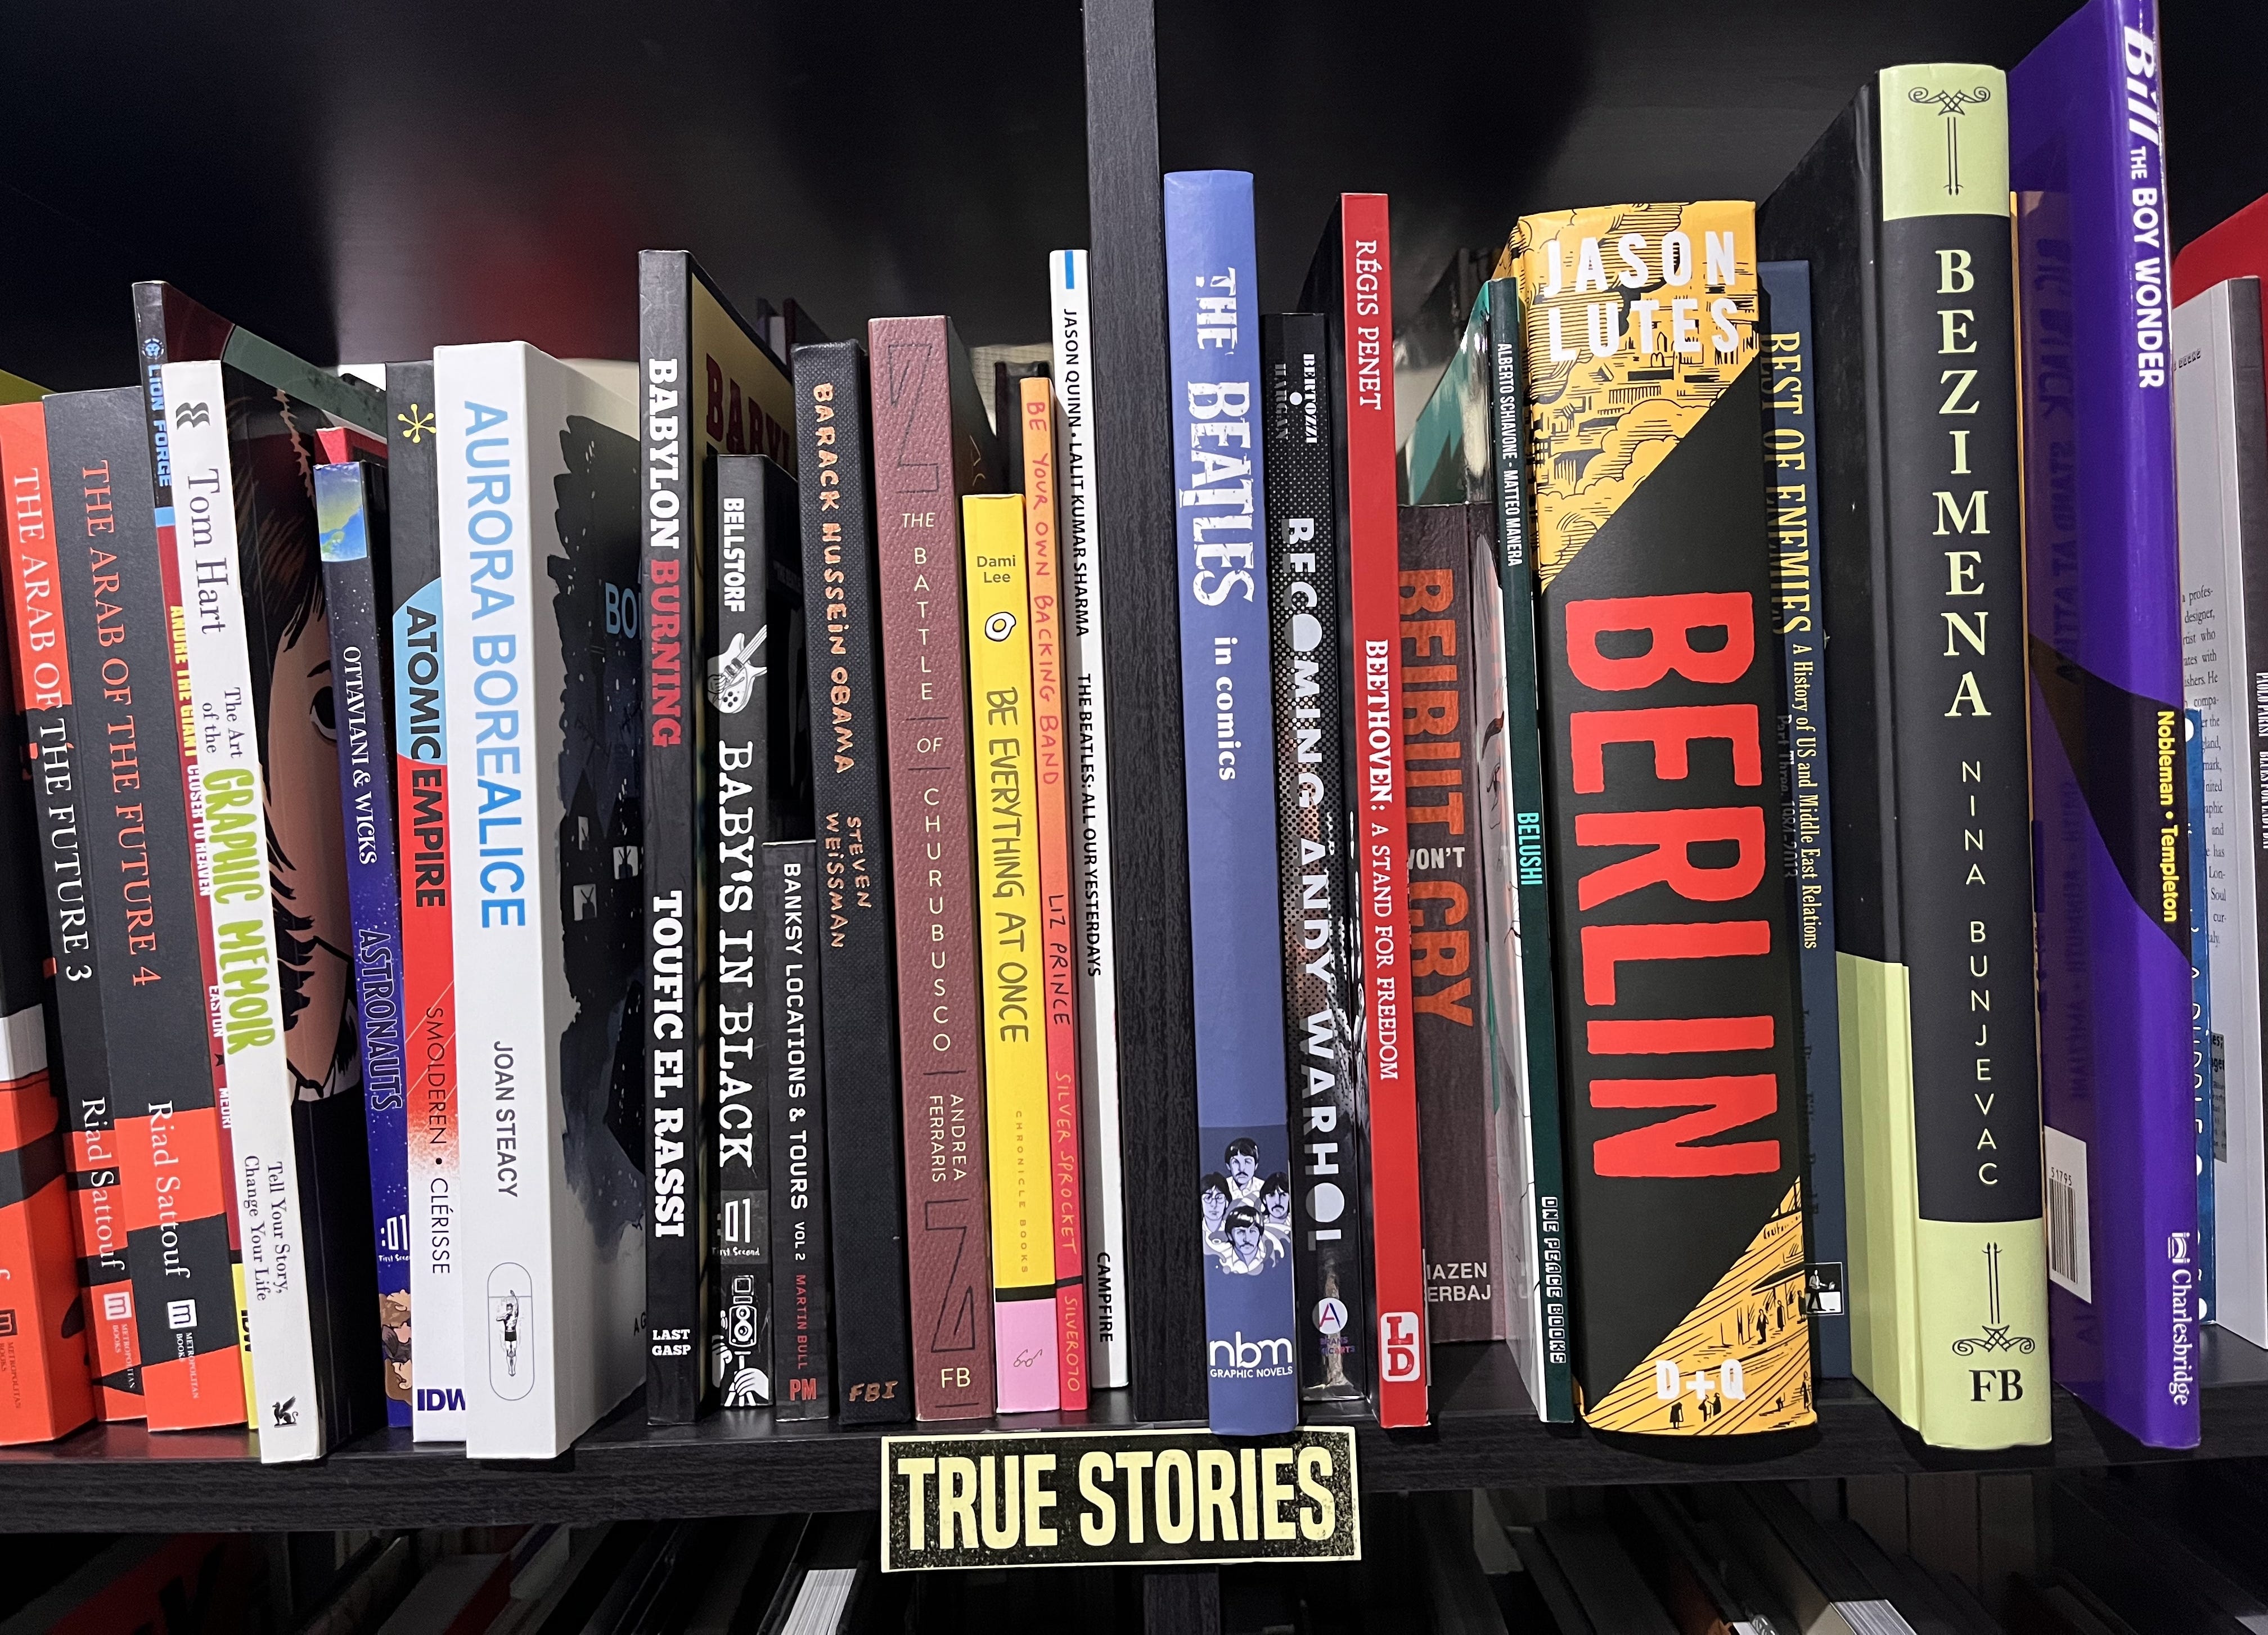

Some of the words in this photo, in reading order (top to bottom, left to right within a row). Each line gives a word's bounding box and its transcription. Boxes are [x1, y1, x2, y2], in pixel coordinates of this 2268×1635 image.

[2125, 26, 2159, 146] Bill
[2130, 146, 2146, 179] THE
[2132, 188, 2159, 248] BOY
[1355, 240, 1382, 316] RÉGIS
[1543, 231, 1736, 299] JASON
[1064, 308, 1078, 365] JASON
[1195, 267, 1238, 355] THE
[1547, 297, 1740, 364] LUTES
[2135, 257, 2165, 388] WONDER
[148, 364, 164, 411] LION
[1065, 370, 1082, 427] QUINN
[1303, 354, 1317, 443] BERTOZZI
[1357, 326, 1382, 411] PENET
[1497, 343, 1515, 394] ALBERTO
[1027, 402, 1047, 432] BE
[1500, 397, 1518, 460] SCHIAVONE
[649, 358, 681, 549] BABYLON
[1032, 453, 1050, 510] YOUR
[1069, 443, 1083, 490] LALIT
[1932, 249, 1991, 717] BEZIMENA
[14, 467, 46, 544] THE
[82, 460, 115, 537] THE
[187, 469, 220, 548] Tom
[464, 400, 515, 620] AURORA
[902, 512, 936, 528] THE
[1180, 381, 1256, 607] BEATLES
[1503, 469, 1520, 516] MATTEO
[723, 497, 745, 612] BELLSTORF
[1035, 522, 1050, 576] OWN
[1071, 495, 1086, 557] KUMAR
[1505, 518, 1522, 567] MANERA
[813, 382, 841, 511] BARACK
[830, 666, 854, 774] OBAMA
[976, 555, 1016, 567] Dami
[984, 570, 1011, 583] Lee
[22, 555, 56, 652] ARAB
[90, 547, 125, 647] ARAB
[195, 558, 228, 634] Hart
[1074, 562, 1089, 637] SHARMA
[2184, 609, 2215, 625] designer,
[2189, 584, 2213, 606] profes-
[650, 559, 682, 747] BURNING
[1034, 595, 1056, 702] BACKING
[1793, 643, 1812, 655] A
[2200, 628, 2216, 642] who
[2202, 648, 2217, 663] with
[35, 661, 62, 709] OF
[101, 658, 132, 705] OF
[224, 687, 242, 722] The
[343, 646, 370, 765] OTTAVIANI
[406, 606, 442, 760] ATOMIC
[986, 687, 1019, 727] BE
[1078, 673, 1092, 706] THE
[1792, 661, 1814, 711] History
[2207, 670, 2218, 684] He
[202, 702, 219, 720] of
[204, 724, 221, 753] the
[1216, 676, 1242, 781] comics
[1366, 639, 1392, 812] BEETHOVEN:
[1796, 717, 1816, 732] of
[2210, 714, 2220, 727] the
[40, 719, 72, 795] THE
[107, 715, 141, 794] THE
[228, 728, 245, 759] Art
[916, 737, 943, 753] OF
[1040, 715, 1059, 785] BAND
[1079, 711, 1094, 788] BEATLES:
[1796, 737, 1816, 758] US
[1797, 763, 1818, 787] and
[2158, 710, 2176, 806] Nobleman
[353, 769, 371, 788] &
[472, 634, 526, 929] BOREALICE
[1082, 792, 1096, 824] ALL
[203, 768, 264, 904] GRAPHIC
[354, 791, 377, 864] WICKS
[412, 769, 446, 907] EMPIRE
[719, 740, 754, 913] BABY'S
[988, 738, 1025, 898] EVERYTHING
[1083, 828, 1097, 866] OUR
[1371, 822, 1389, 837] A
[1518, 812, 1544, 885] BELUSHI
[1799, 794, 1820, 843] Middle
[2211, 822, 2224, 836] and
[49, 804, 89, 954] FUTURE
[115, 803, 157, 955] FUTURE
[847, 816, 872, 908] STEVEN
[1372, 845, 1393, 917] STAND
[1801, 848, 1821, 880] East
[2161, 824, 2180, 923] Templeton
[2213, 846, 2225, 858] has
[784, 863, 803, 954] BANKSY
[1048, 894, 1066, 929] LIZ
[1565, 591, 1781, 1178] BERLIN
[2211, 887, 2226, 901] Soul
[995, 912, 1027, 953] AT
[1084, 868, 1101, 977] YESTERDAYS
[1375, 925, 1394, 969] FOR
[1802, 885, 1822, 949] Relations
[66, 966, 92, 981] 3
[132, 966, 161, 986] 4
[217, 920, 275, 1055] MEMOIR
[652, 890, 683, 1040] TOUFIC
[719, 929, 754, 988] IN
[1050, 943, 1070, 1025] PRINCE
[359, 929, 403, 1111] ASTRONAUTS
[786, 964, 806, 1098] LOCATIONS
[997, 962, 1029, 1042] ONCE
[1376, 977, 1398, 1080] FREEDOM
[426, 1007, 447, 1145] SMOLDEREN
[494, 1041, 514, 1101] JOAN
[654, 1049, 683, 1098] EL
[718, 1002, 754, 1168] BLACK
[83, 1098, 112, 1162] Riad
[148, 1100, 173, 1167] Riad
[789, 1108, 806, 1123] &
[929, 1095, 947, 1182] FERRARIS
[950, 1094, 968, 1181] ANDREA
[1056, 1071, 1072, 1142] SILVER
[268, 1161, 285, 1193] Tell
[496, 1109, 518, 1197] STEACY
[654, 1108, 685, 1237] RASSI
[789, 1130, 808, 1210] TOURS
[1015, 1111, 1026, 1209] CHRONICLE
[244, 1156, 260, 1217] Change
[272, 1197, 286, 1238] Your
[1058, 1151, 1077, 1255] SPROCKET
[1541, 1196, 1560, 1232] ONE
[91, 1170, 125, 1271] Sattouf
[155, 1176, 191, 1279] Sattouf
[251, 1220, 266, 1263] Your
[430, 1178, 453, 1273] CLÉRISSE
[795, 1221, 806, 1249] VOL
[1019, 1219, 1028, 1273] BOOKS
[255, 1268, 271, 1301] Life
[273, 1244, 290, 1294] Story,
[1097, 1252, 1113, 1343] CAMPFIRE
[1544, 1237, 1563, 1298] PEACE
[652, 1328, 690, 1340] LAST
[796, 1274, 807, 1330] MARTIN
[1547, 1303, 1567, 1364] BOOKS
[120, 1324, 136, 1389] METROPOLITAN
[185, 1332, 199, 1399] METROPOLITAN
[651, 1345, 691, 1356] GASP
[797, 1335, 808, 1370] BULL
[2168, 1268, 2192, 1407] Charlesbridge
[849, 1381, 899, 1402] FBI
[941, 1367, 971, 1388] FB
[1210, 1368, 1254, 1378] GRAPHIC
[1257, 1366, 1293, 1378] NOVELS
[1969, 1369, 2024, 1402] FB
[897, 1453, 1058, 1551] TRUE
[1078, 1445, 1336, 1547] STORIES
